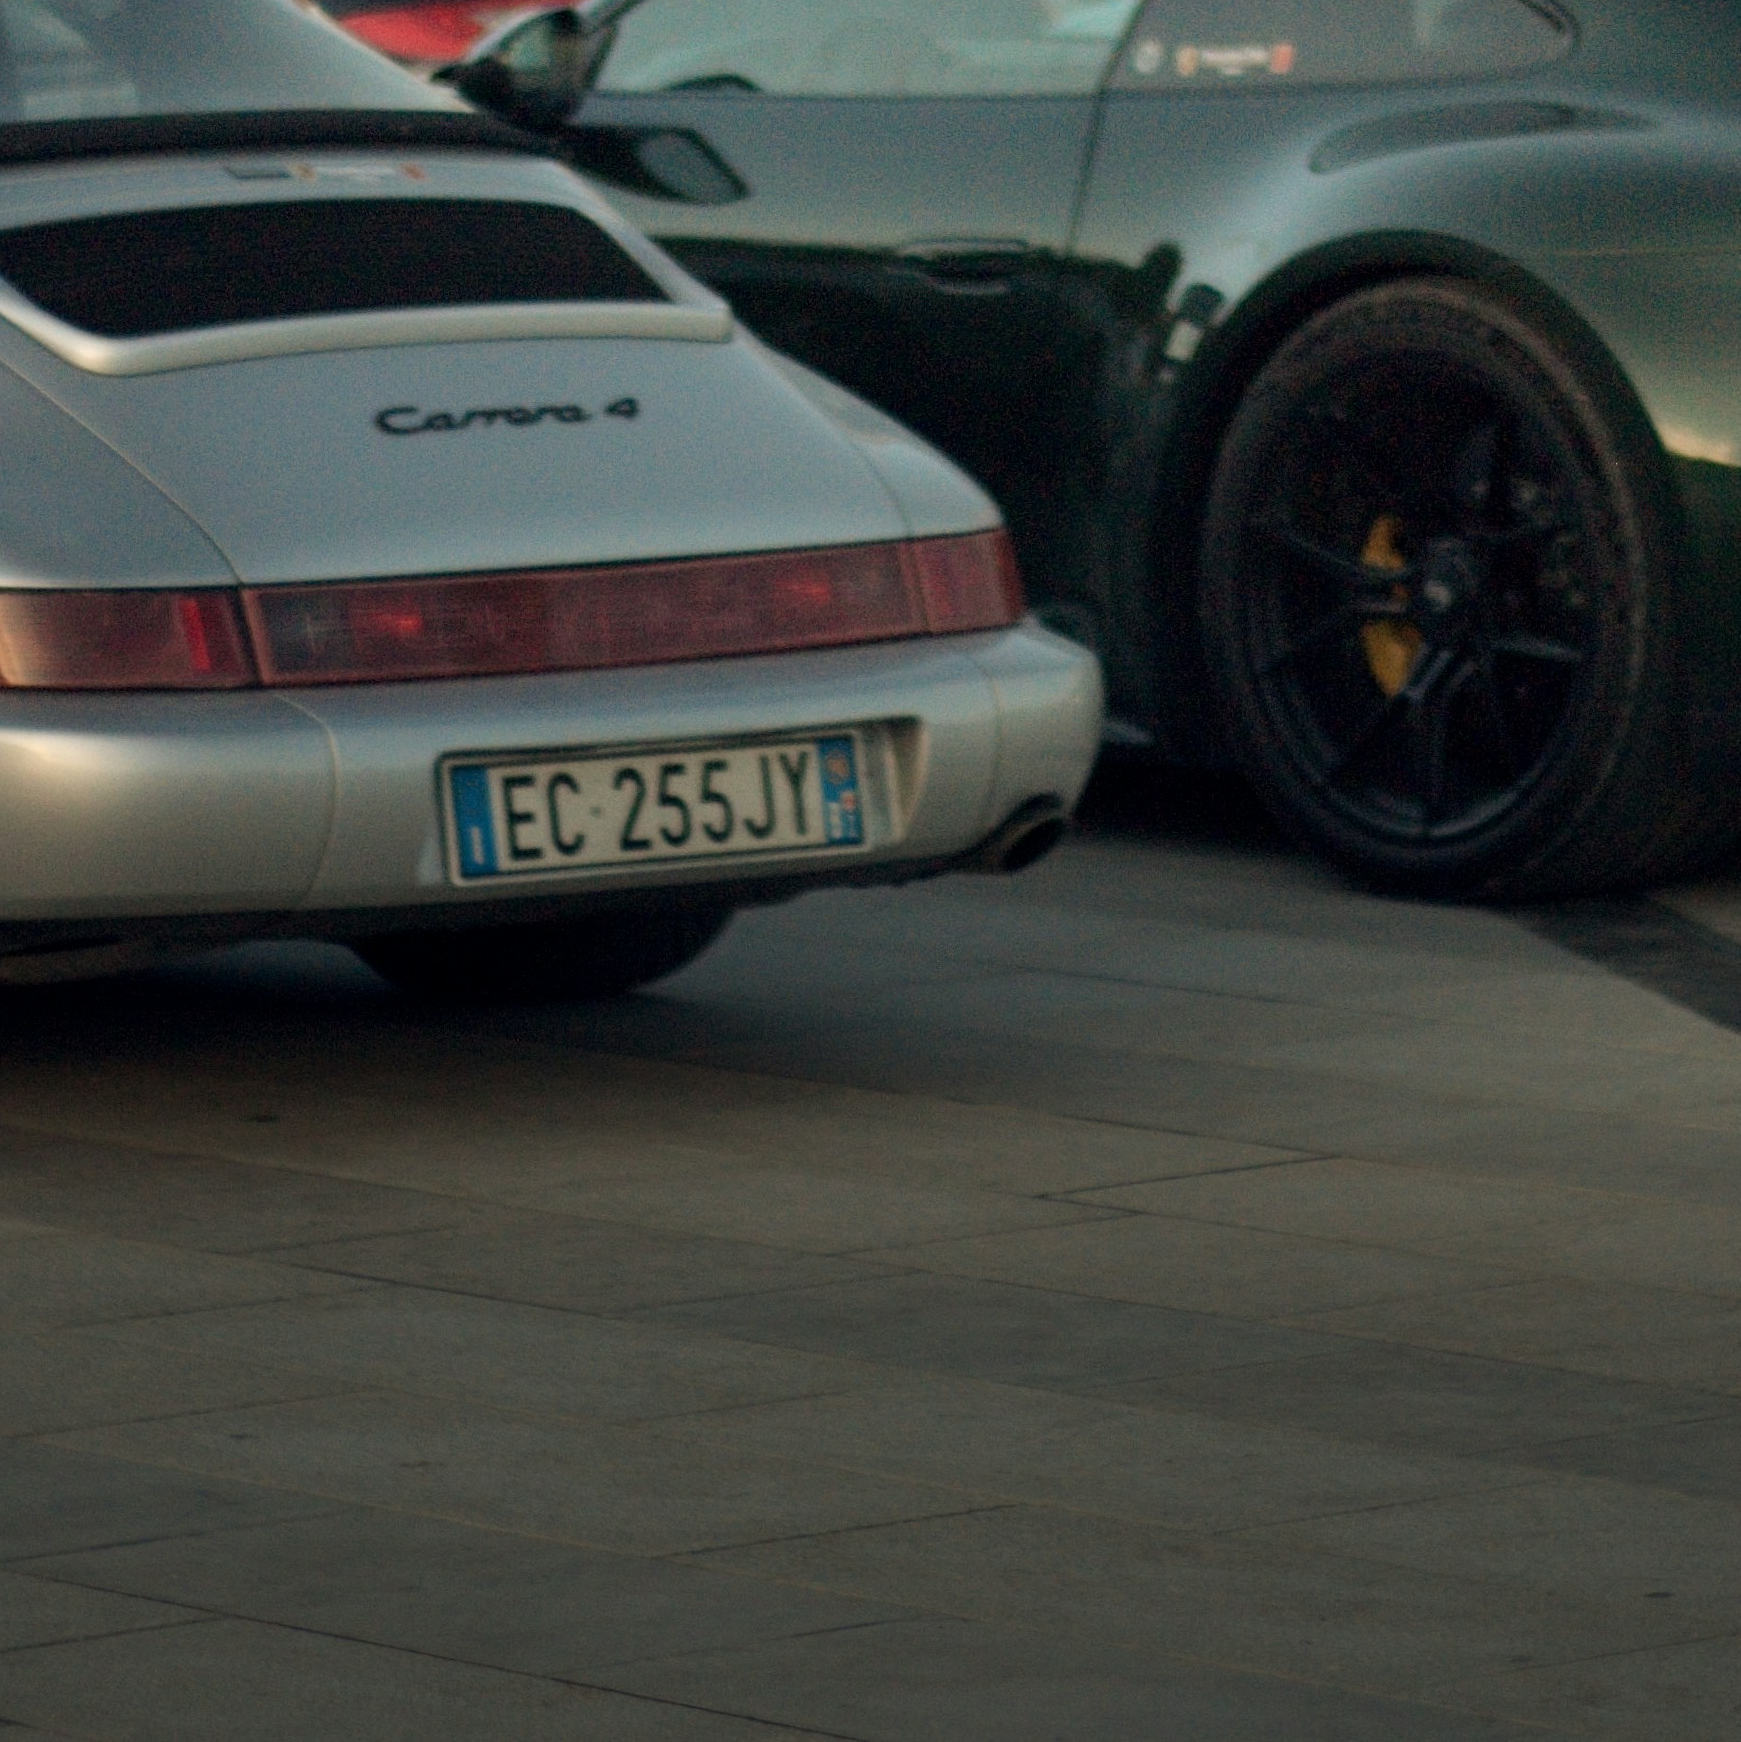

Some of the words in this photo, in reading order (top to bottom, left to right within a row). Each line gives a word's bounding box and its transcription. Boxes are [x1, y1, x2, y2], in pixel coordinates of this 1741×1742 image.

[373, 404, 590, 438] Carrera
[605, 396, 640, 420] 4
[501, 771, 585, 862] EC
[613, 752, 809, 852] 255JY
